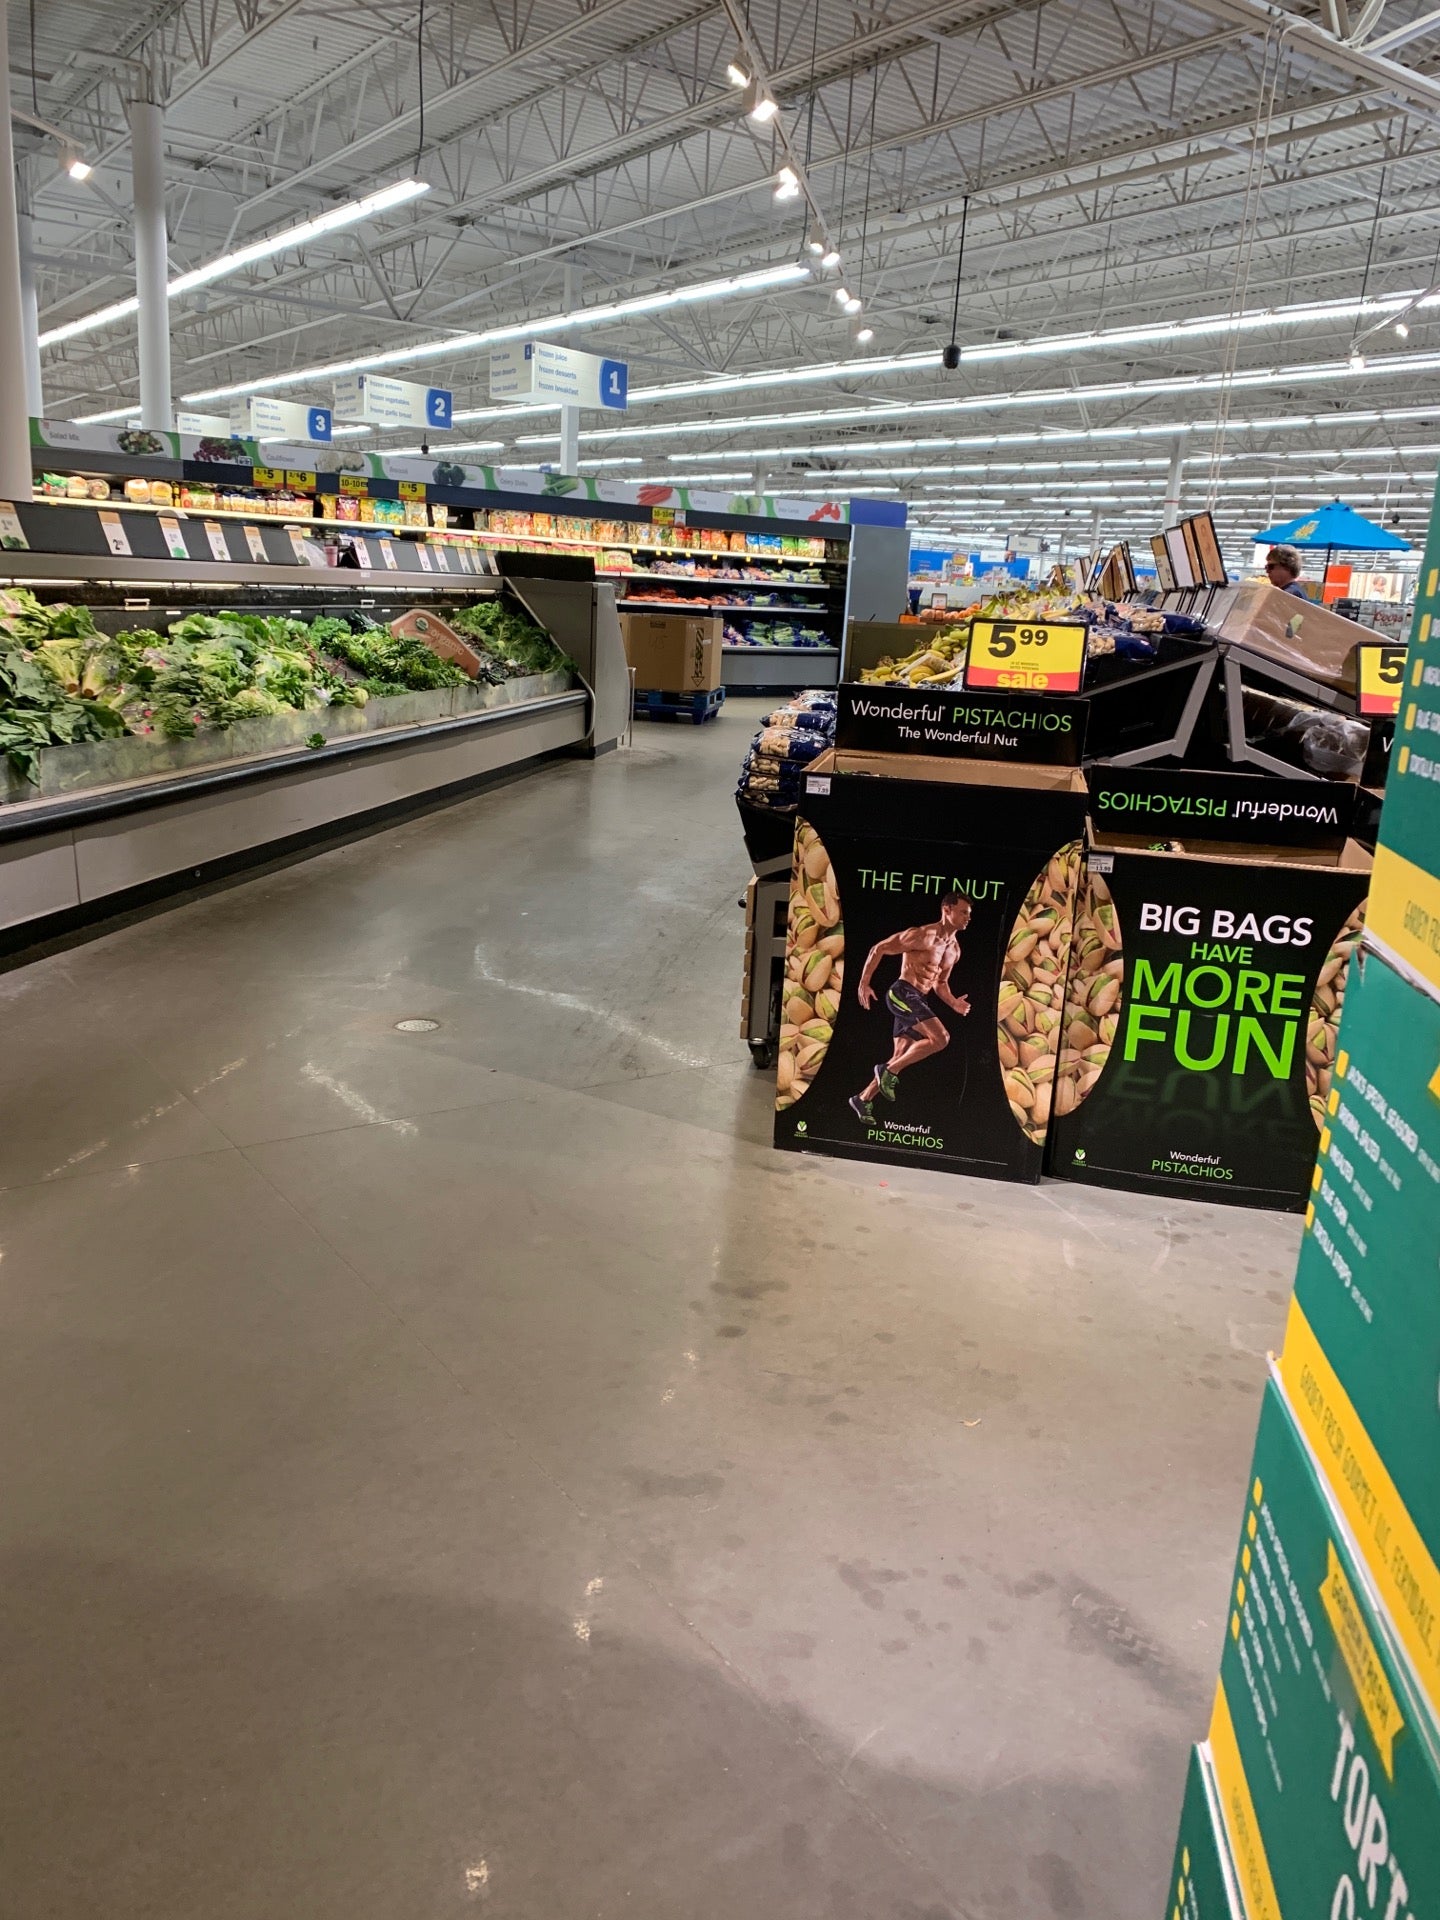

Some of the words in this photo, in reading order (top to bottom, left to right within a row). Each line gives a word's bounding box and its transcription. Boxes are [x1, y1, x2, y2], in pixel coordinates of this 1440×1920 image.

[609, 370, 621, 395] 1
[434, 397, 446, 417] 2
[315, 414, 326, 432] 3
[49, 431, 67, 440] Salad
[266, 454, 296, 463] Cauliflower
[997, 672, 1049, 689] sale
[851, 699, 944, 722] Wonderful
[953, 707, 1072, 732] PISTACHIOS
[898, 726, 921, 740] The
[924, 728, 991, 745] Wonderful
[994, 733, 1018, 747] Nut
[1098, 791, 1228, 817] PISTACHIOS
[1235, 800, 1339, 824] Wonderful
[857, 868, 903, 891] THE
[911, 873, 946, 895] FIT
[952, 877, 1005, 900] NUT
[1139, 902, 1201, 936] BIG
[1211, 909, 1314, 946] BAGS
[1190, 941, 1254, 965] HAVE
[1131, 958, 1306, 1017] MORE
[1123, 1003, 1298, 1080] FUN
[884, 1120, 930, 1134] Wonderful
[867, 1129, 944, 1150] PISTACHIOS
[1169, 1151, 1221, 1165] Wonderful
[1151, 1159, 1234, 1180] PISTACHIOS
